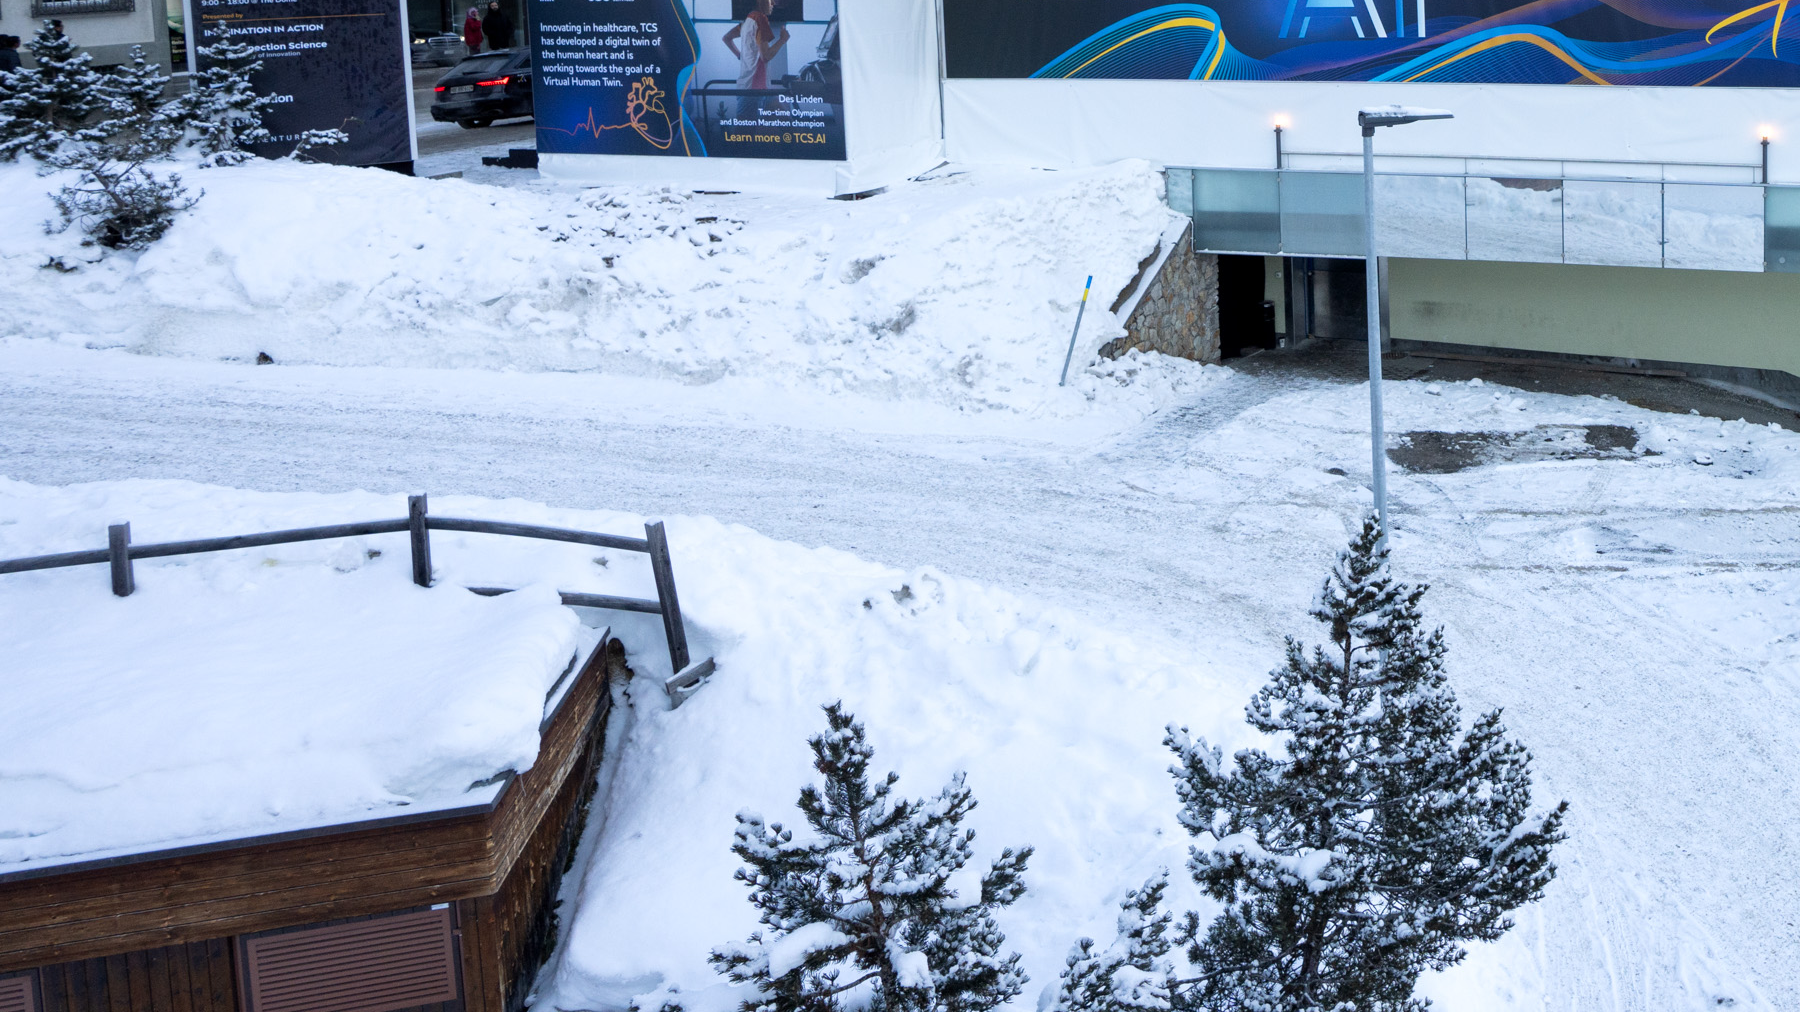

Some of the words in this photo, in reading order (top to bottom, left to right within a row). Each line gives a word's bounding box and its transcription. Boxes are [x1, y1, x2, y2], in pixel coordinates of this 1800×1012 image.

[234, 12, 244, 20] by
[204, 25, 272, 38] IMINATION
[274, 24, 285, 33] IN
[287, 24, 324, 33] ACTION
[540, 22, 582, 34] Innovating
[583, 22, 592, 32] in
[593, 23, 639, 34] healthcare,
[640, 23, 658, 33] TCS
[288, 40, 328, 50] Science
[541, 36, 555, 46] has
[556, 36, 597, 48] developed
[605, 36, 630, 49] digital
[631, 37, 650, 47] twin
[651, 37, 662, 47] of
[541, 50, 556, 59] the
[556, 50, 584, 59] human
[586, 50, 608, 60] heart
[610, 50, 625, 60] and
[627, 50, 634, 60] is
[542, 63, 574, 75] working
[575, 63, 608, 74] towards
[609, 63, 624, 73] the
[625, 64, 643, 76] goal
[644, 64, 654, 74] of
[655, 66, 661, 74] a
[543, 76, 570, 87] Virtual
[572, 77, 601, 87] Human
[602, 77, 624, 87] Twin.
[778, 94, 794, 104] Des
[796, 94, 823, 104] Linden
[758, 108, 791, 117] Two-time
[792, 108, 824, 119] Olympian
[720, 118, 732, 126] and
[733, 118, 757, 126] Boston
[758, 119, 791, 127] Marathon
[792, 119, 825, 129] champion
[724, 131, 752, 142] Learn
[754, 134, 781, 143] more
[782, 133, 792, 143] @
